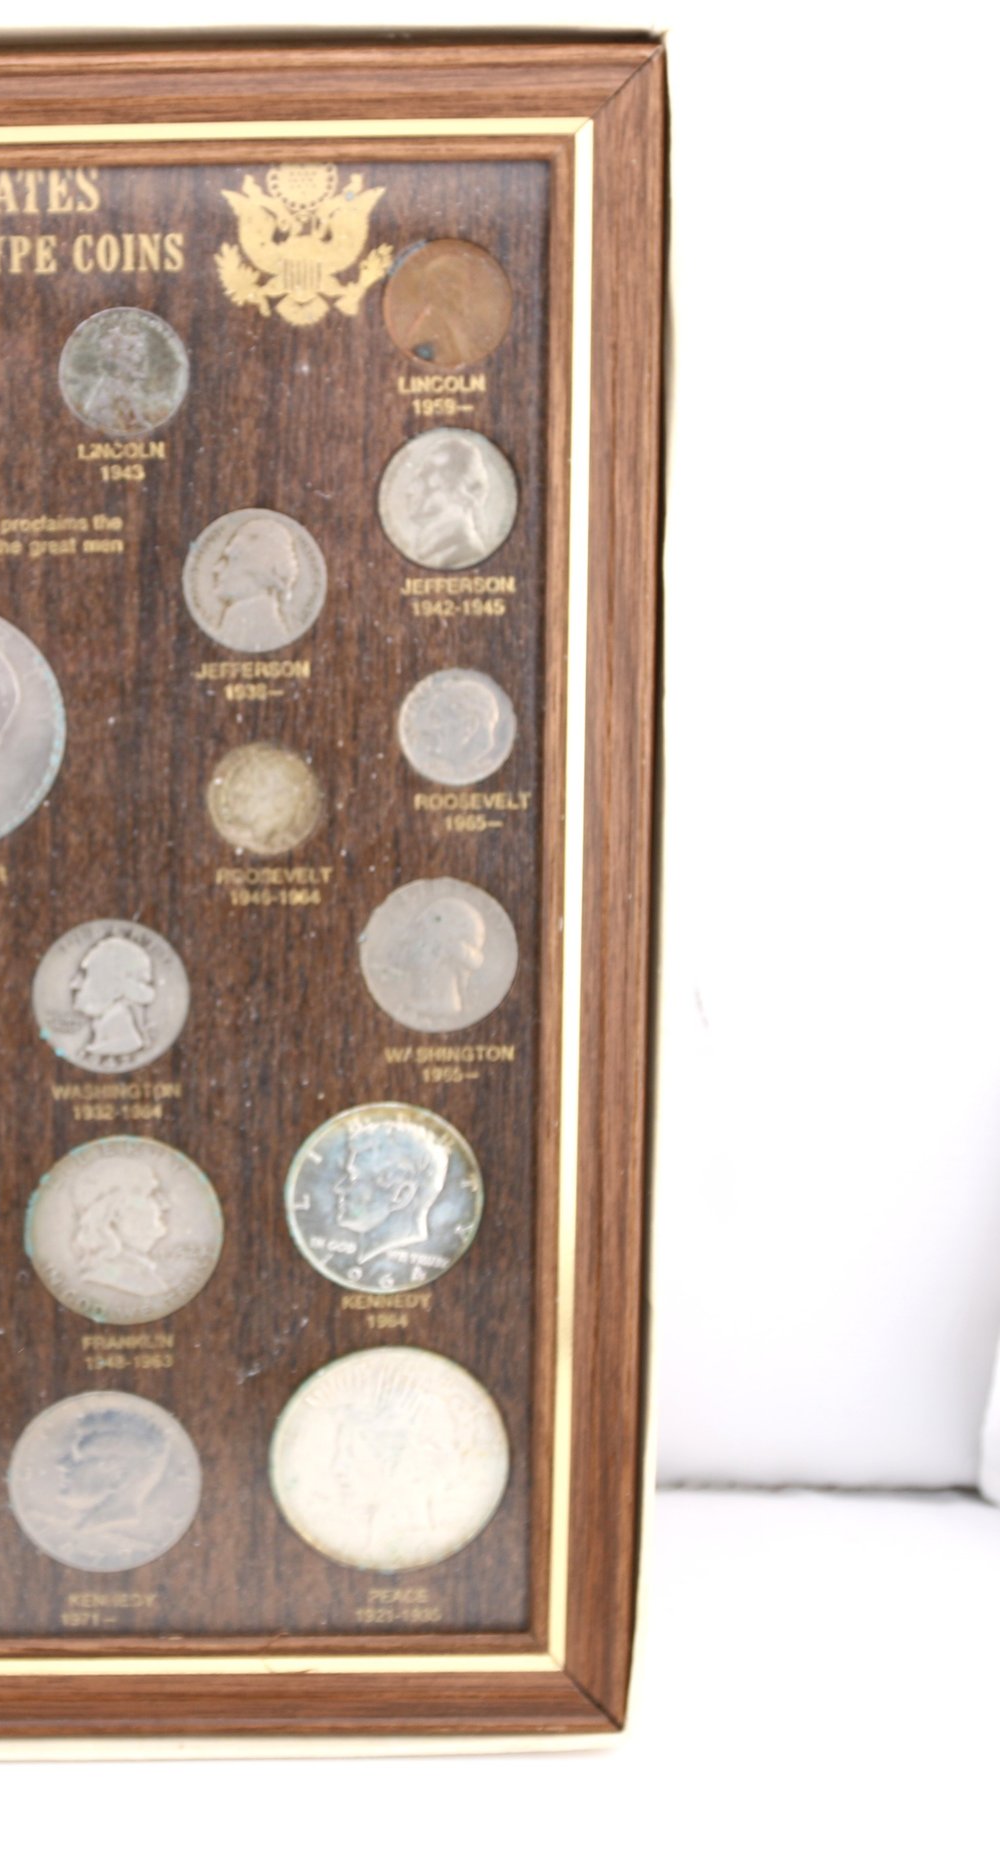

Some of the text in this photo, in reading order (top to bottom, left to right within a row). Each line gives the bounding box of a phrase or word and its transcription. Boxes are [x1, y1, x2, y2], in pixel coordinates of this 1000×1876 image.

[73, 233, 184, 272] COINS
[398, 374, 486, 393] LINCOLN
[400, 576, 516, 596] JEFFERSON
[195, 660, 310, 680] JEFFERSON
[414, 792, 532, 811] ROOSEVELT
[341, 1292, 431, 1312] KENNEDY
